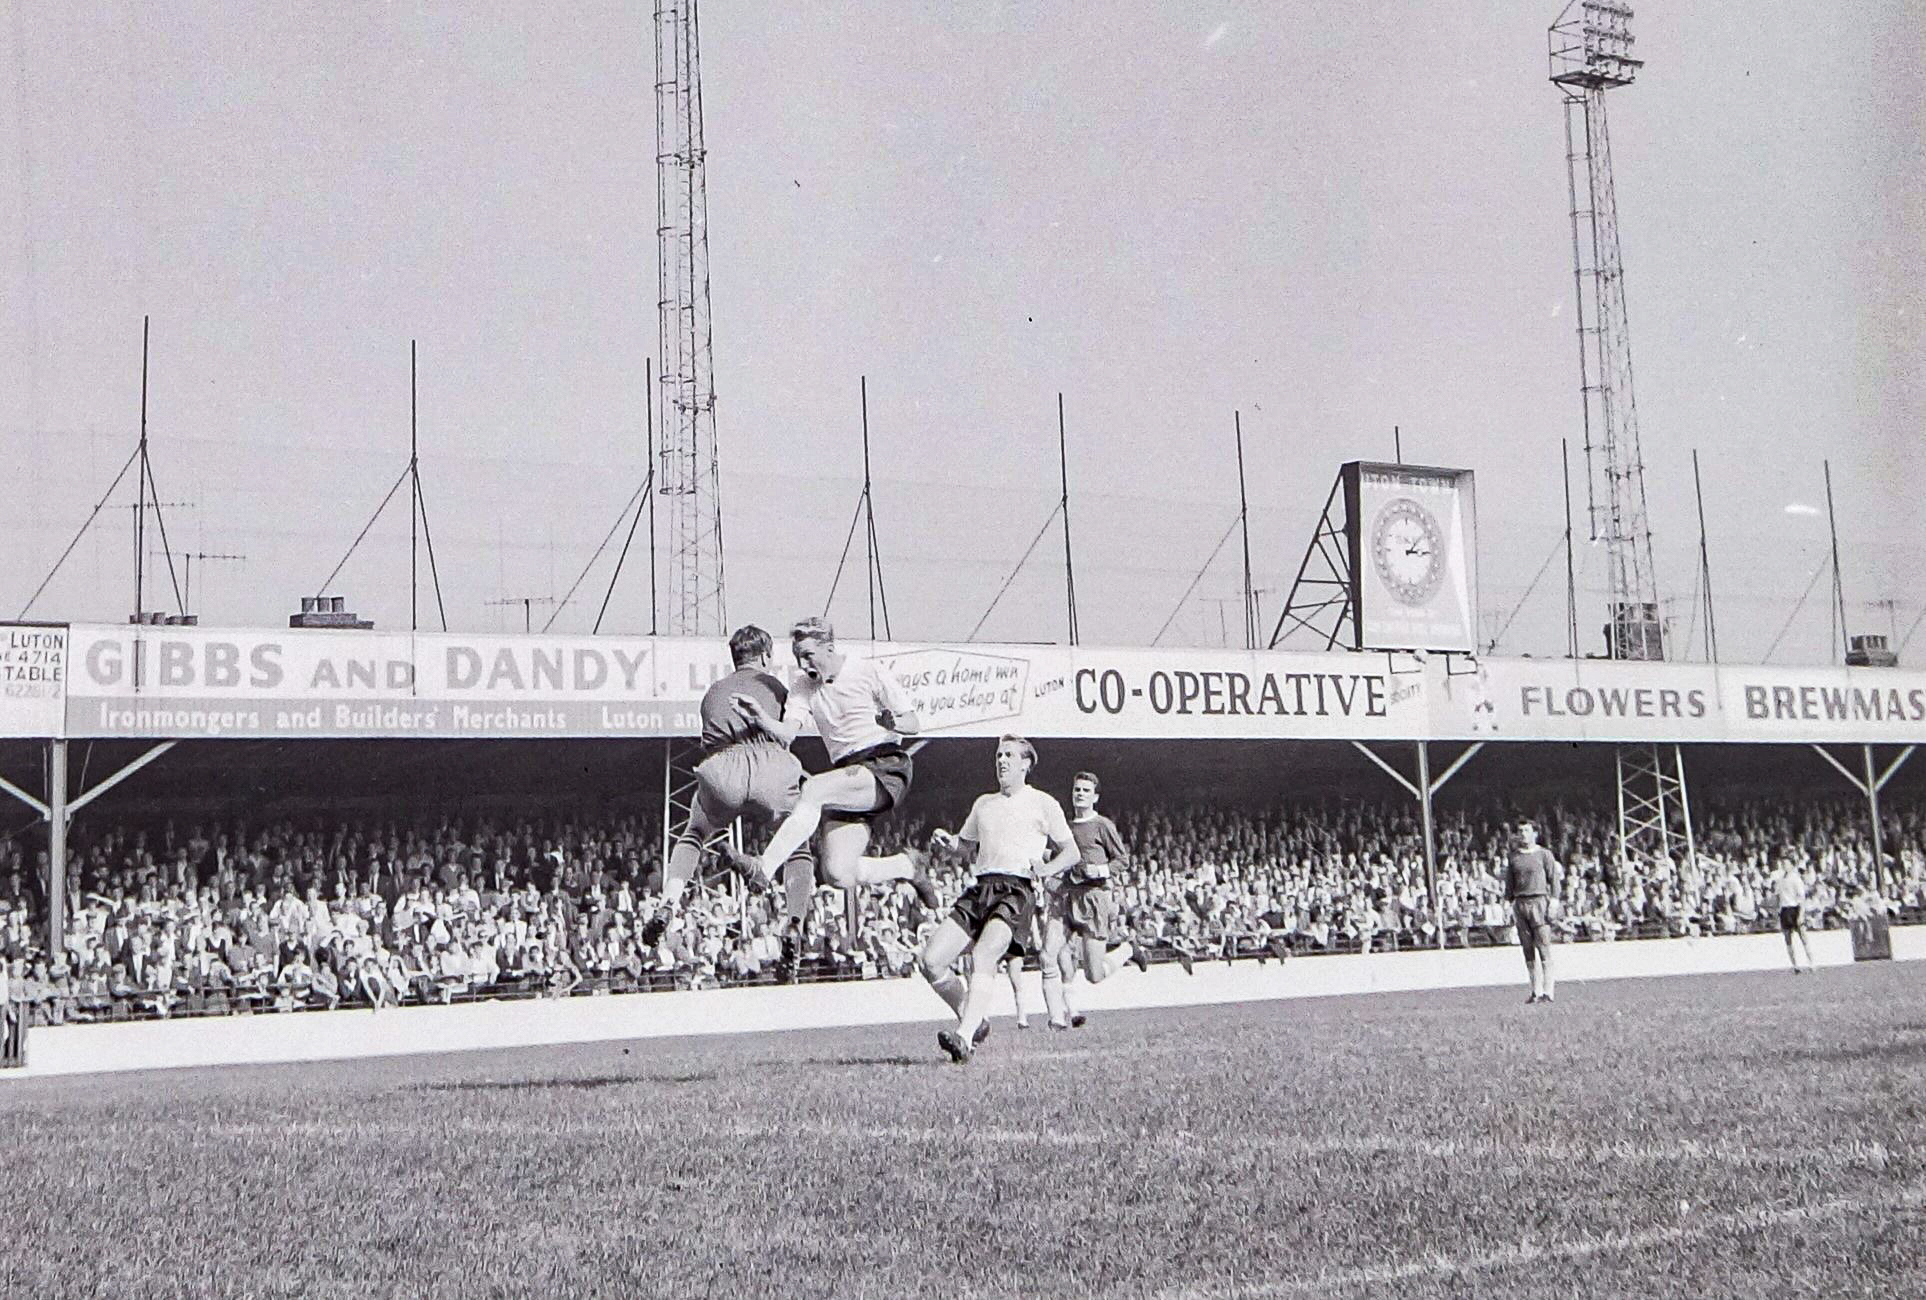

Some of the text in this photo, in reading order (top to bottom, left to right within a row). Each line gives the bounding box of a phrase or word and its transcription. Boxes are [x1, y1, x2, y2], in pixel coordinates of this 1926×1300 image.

[10, 631, 63, 649] LUTON
[18, 650, 61, 664] 4714
[86, 639, 284, 688] GIBBS
[310, 657, 415, 689] AND
[936, 669, 947, 685] a
[950, 657, 991, 683] home
[4, 666, 62, 681] TABLE
[1035, 676, 1065, 698] LUTON
[929, 696, 955, 716] you
[960, 684, 995, 712] shop
[1001, 683, 1017, 711] at
[1075, 668, 1387, 717] CO-OPERATIVE
[1521, 686, 1706, 718] FLOWERS
[1745, 685, 1926, 721] BREWMAS
[100, 702, 260, 734] Ironmongers
[276, 706, 321, 728] and
[452, 705, 567, 729] Merchants
[602, 705, 662, 729] Luton
[674, 711, 699, 729] an
